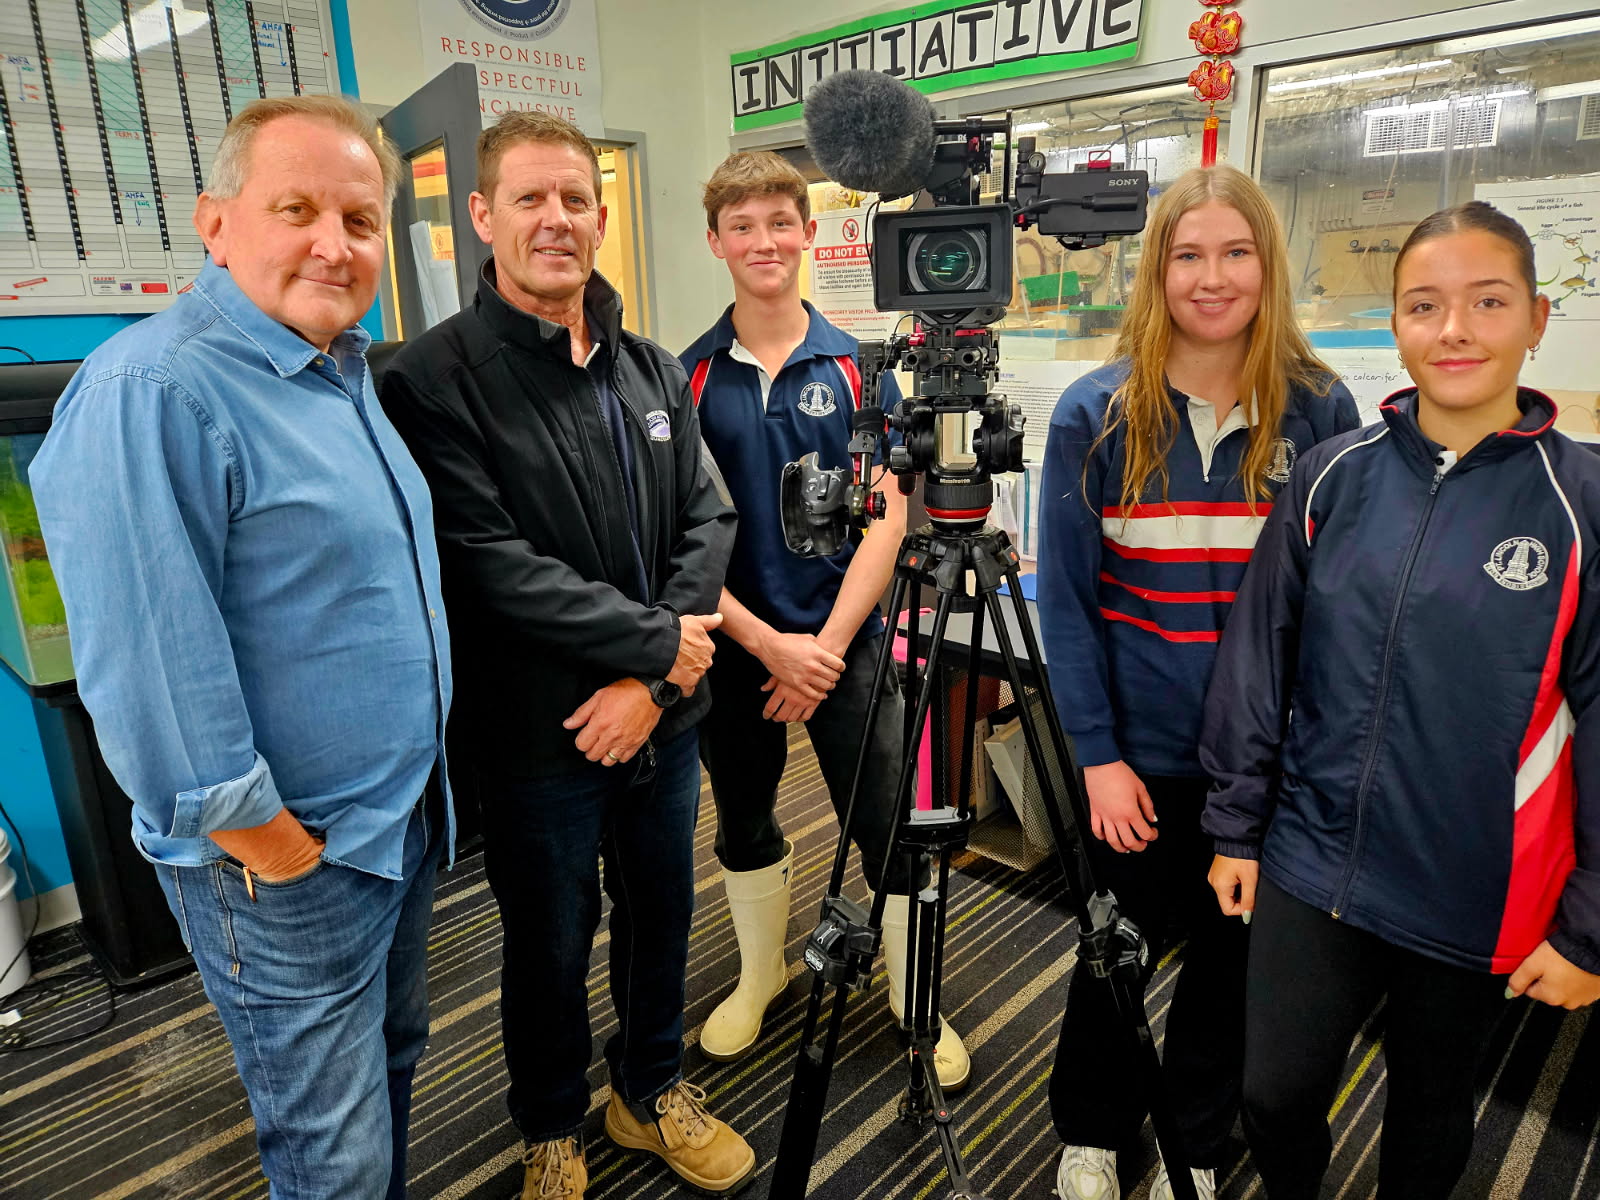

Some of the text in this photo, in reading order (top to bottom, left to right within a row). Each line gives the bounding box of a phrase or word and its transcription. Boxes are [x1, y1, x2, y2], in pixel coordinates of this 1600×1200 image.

[440, 37, 587, 72] RESPONSIBLE
[480, 70, 583, 97] SPECTFUL
[479, 98, 577, 121] NCLUSIVE
[1108, 178, 1140, 187] SONY
[818, 249, 833, 259] DO
[834, 247, 854, 258] NOT
